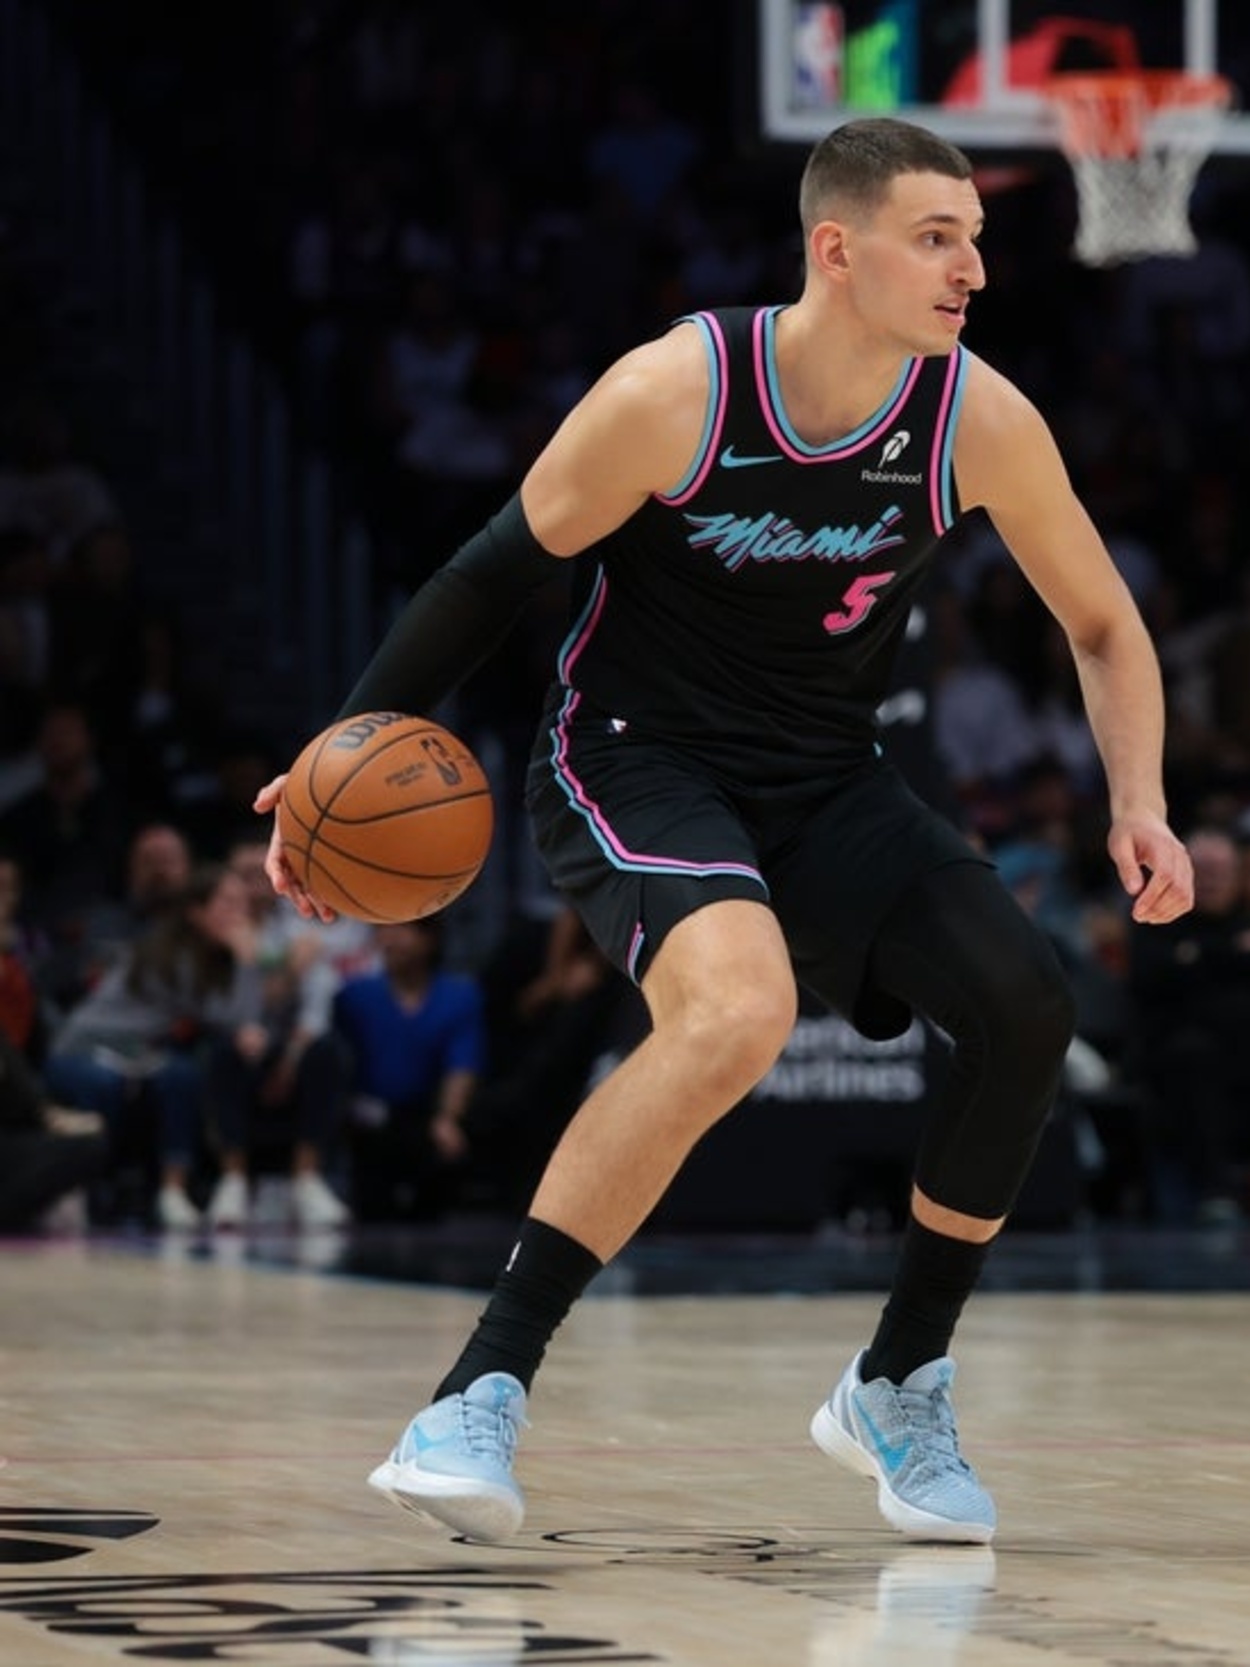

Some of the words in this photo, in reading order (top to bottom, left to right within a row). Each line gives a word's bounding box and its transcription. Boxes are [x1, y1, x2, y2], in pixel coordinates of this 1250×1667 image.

[861, 469, 922, 484] Robinhood
[683, 505, 905, 573] Miami
[822, 571, 897, 635] 5
